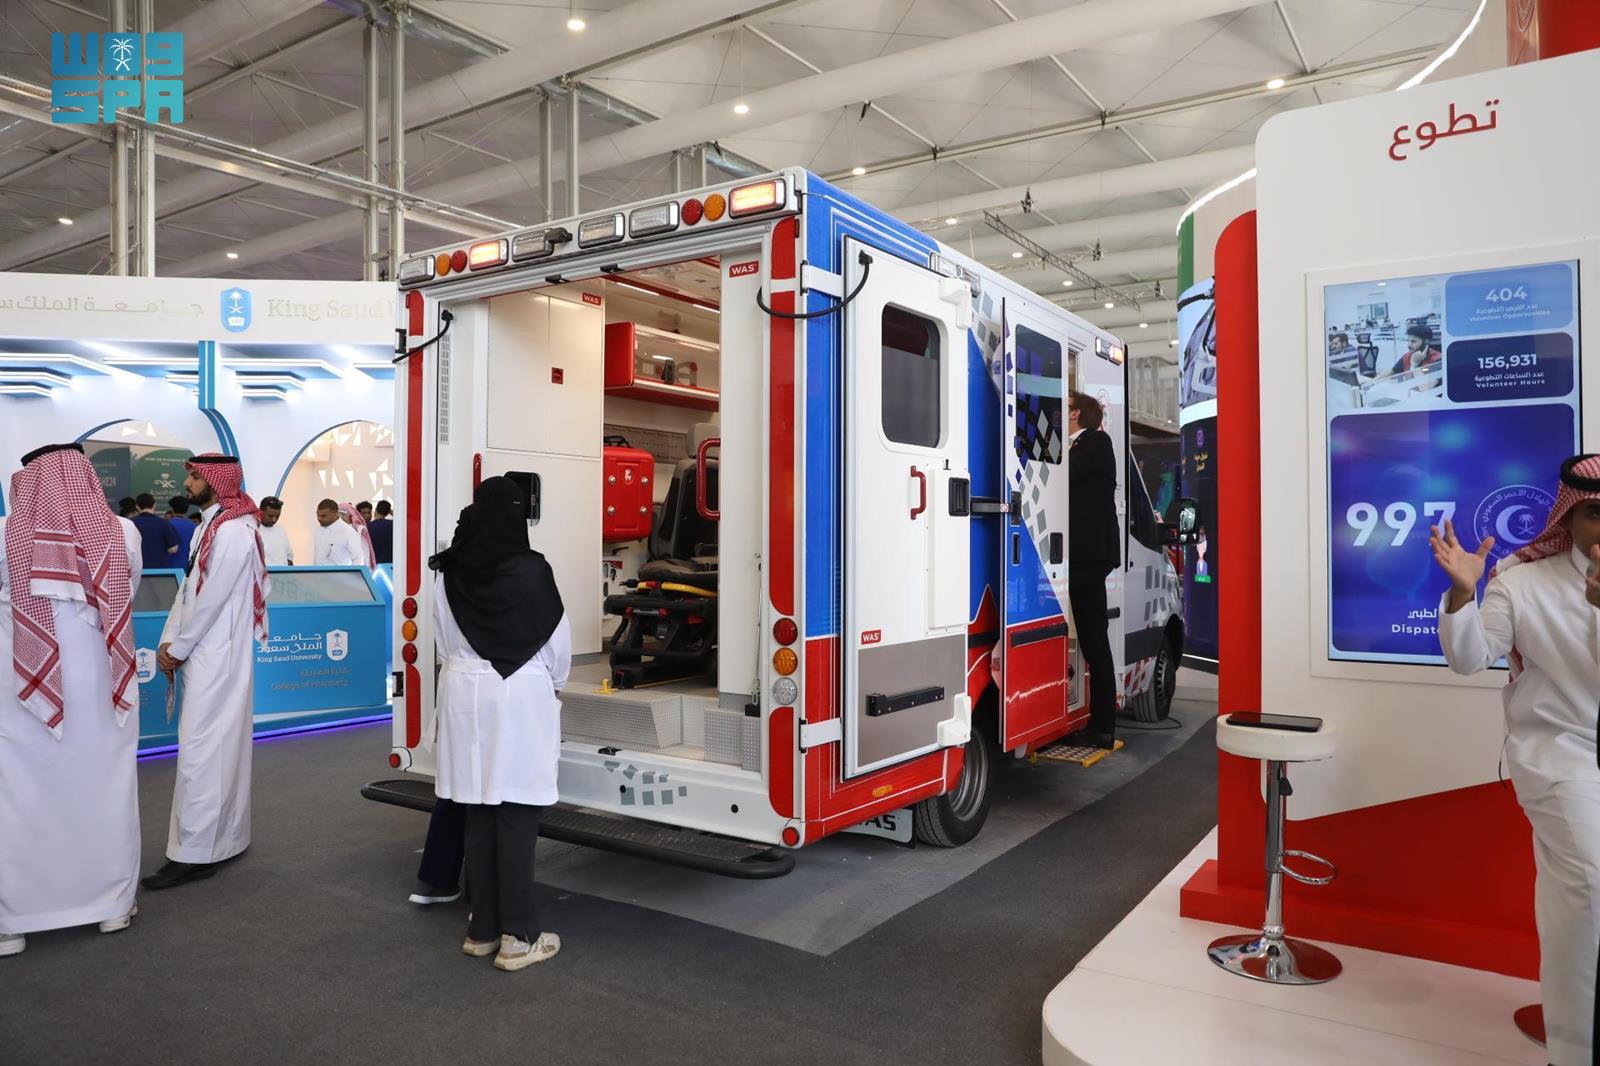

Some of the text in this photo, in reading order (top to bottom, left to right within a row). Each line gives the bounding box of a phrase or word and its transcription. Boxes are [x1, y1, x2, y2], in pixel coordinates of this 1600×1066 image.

[1389, 99, 1500, 161] تطوع
[732, 265, 756, 275] WAS
[583, 294, 599, 304] WAS
[1485, 286, 1527, 302] 404
[17, 295, 79, 312] الملك
[84, 296, 205, 317] جامعة
[267, 299, 321, 322] King
[327, 300, 385, 318] Saud
[1477, 353, 1537, 370] 156,931
[1476, 380, 1518, 389] Volunteer
[1346, 502, 1456, 547] 997
[1391, 623, 1440, 635] Dispat
[862, 633, 879, 642] WAS
[273, 654, 290, 662] Saud
[291, 653, 322, 661] University
[862, 814, 896, 831] AS
